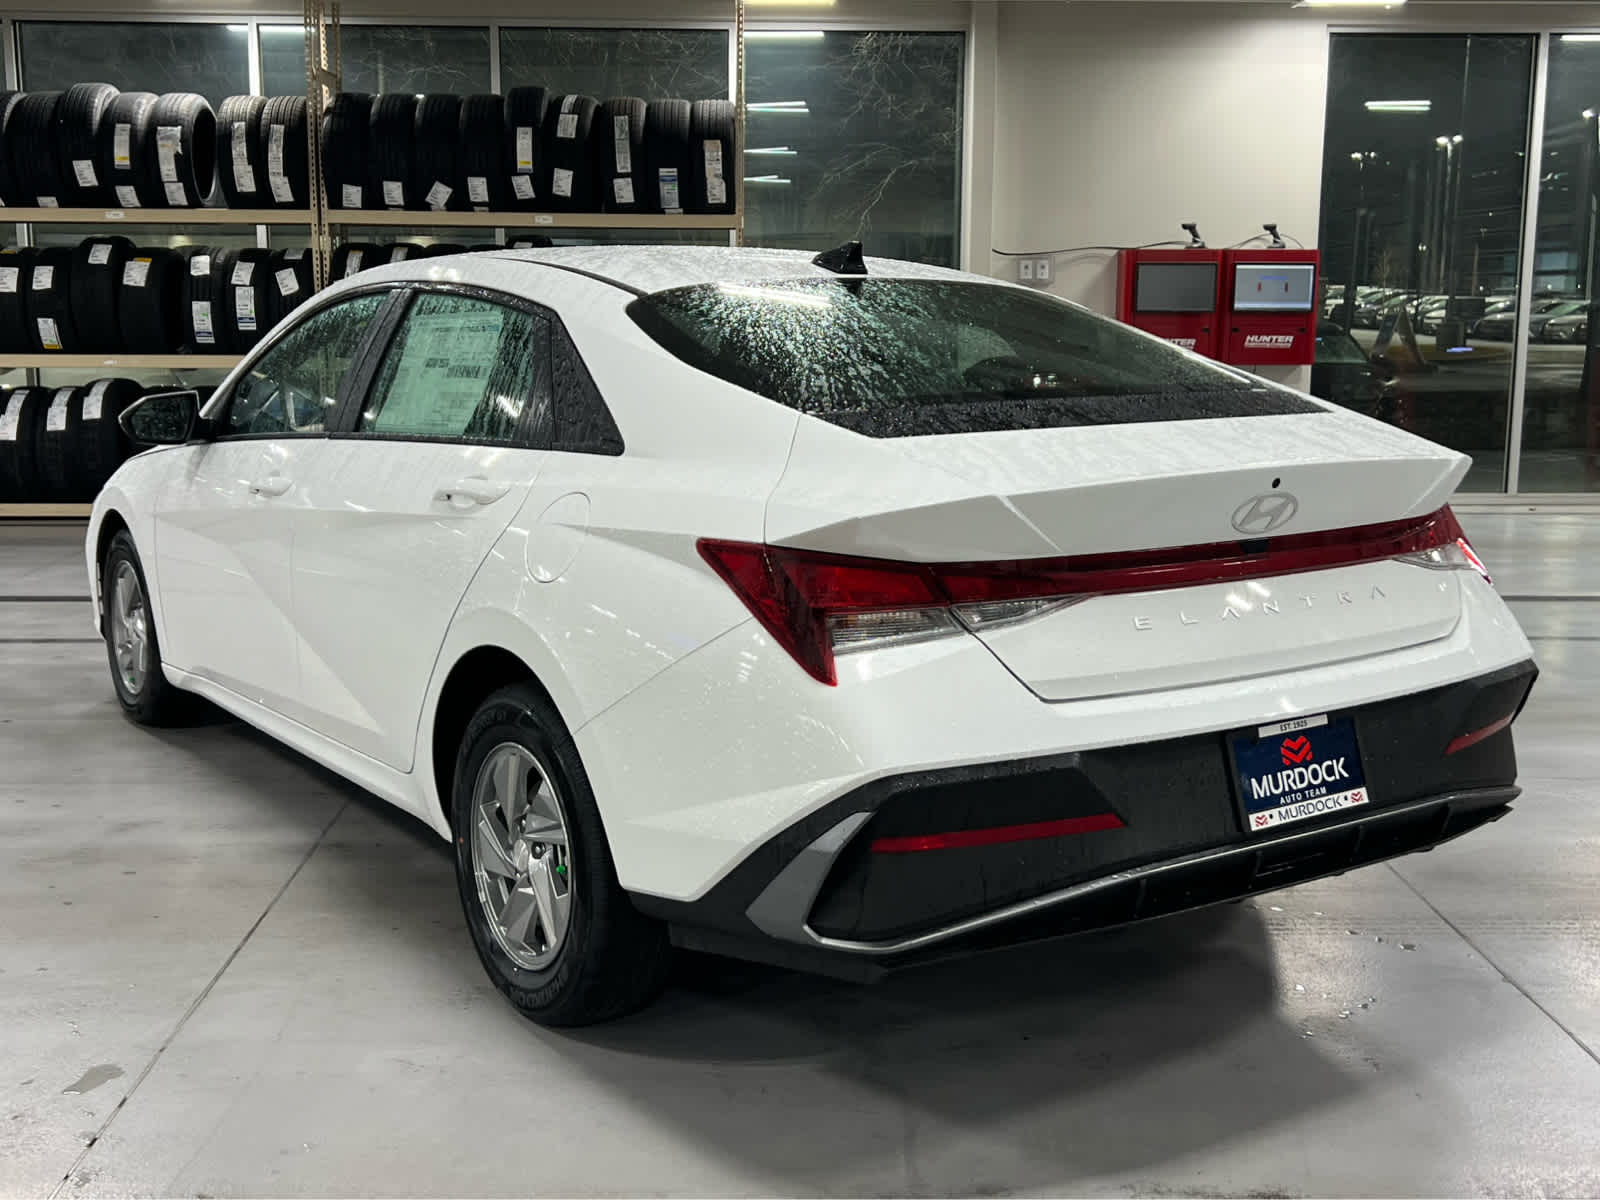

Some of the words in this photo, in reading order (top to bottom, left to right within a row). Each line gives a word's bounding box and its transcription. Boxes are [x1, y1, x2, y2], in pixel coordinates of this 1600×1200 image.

[1244, 334, 1294, 346] HUNTER
[1133, 584, 1387, 631] ELANTRA
[1250, 757, 1349, 799] MURDOCK
[1280, 793, 1302, 805] AUTO
[1304, 786, 1327, 797] TEAM
[1278, 797, 1343, 821] MURDOCK
